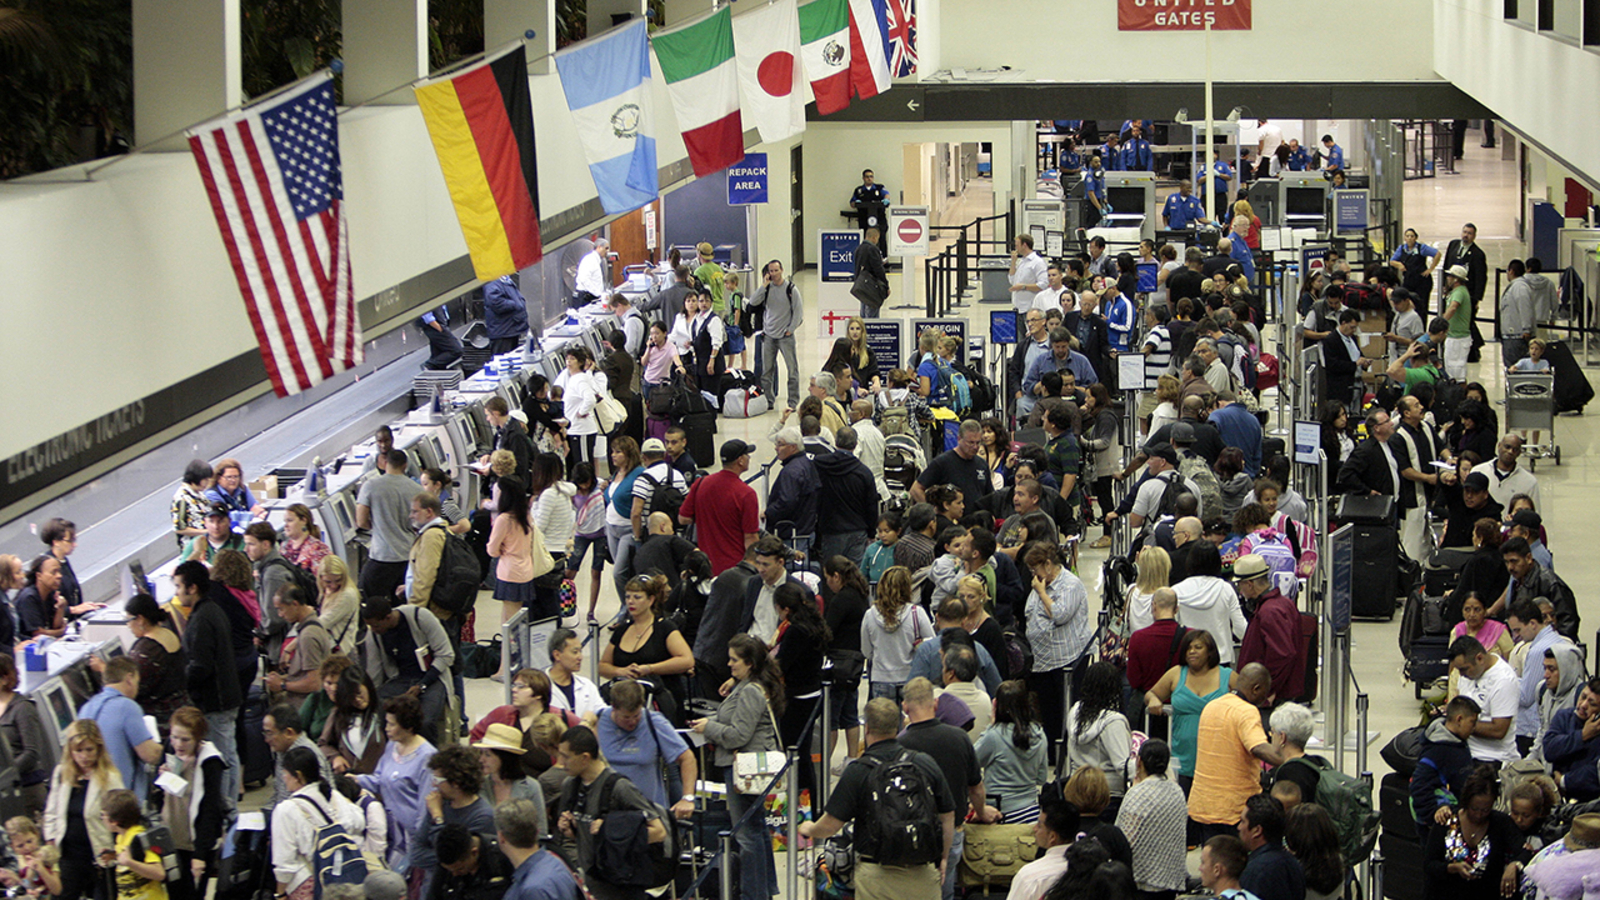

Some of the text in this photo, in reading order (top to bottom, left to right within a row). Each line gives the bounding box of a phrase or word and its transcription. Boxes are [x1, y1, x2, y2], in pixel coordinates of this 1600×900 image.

[1154, 12, 1216, 25] GATES
[729, 167, 767, 176] REPACK
[734, 181, 762, 190] AREA
[829, 250, 853, 263] Exit
[934, 324, 960, 333] BEGIN
